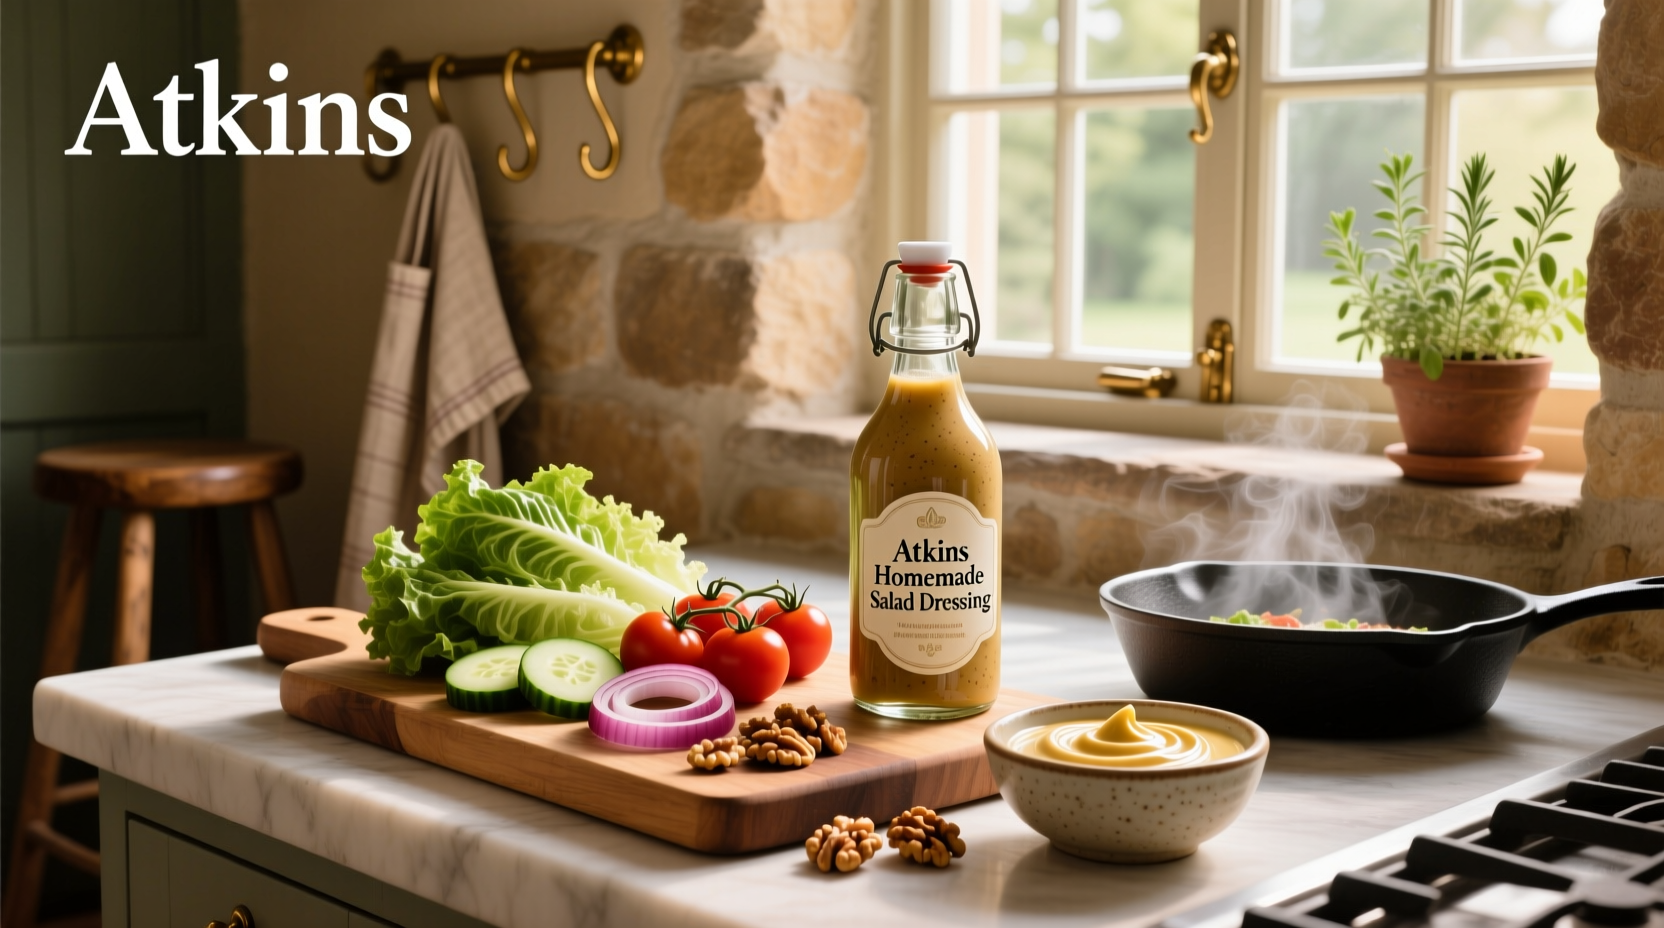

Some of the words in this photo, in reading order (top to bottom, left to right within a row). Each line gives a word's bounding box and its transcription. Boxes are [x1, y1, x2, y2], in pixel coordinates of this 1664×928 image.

[892, 538, 969, 563] Atkins
[874, 564, 984, 587] Homemade
[870, 590, 914, 611] Salad
[919, 592, 991, 613] Dressing
